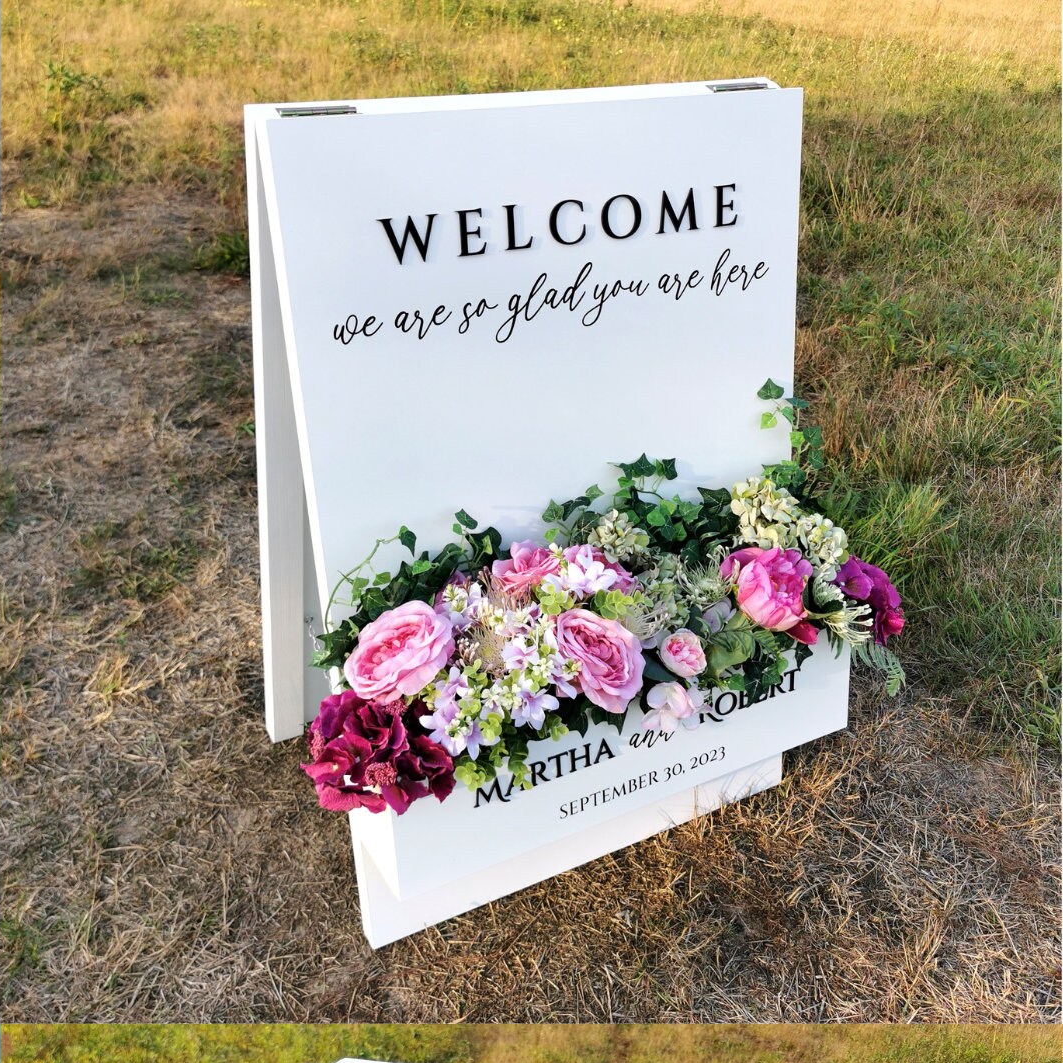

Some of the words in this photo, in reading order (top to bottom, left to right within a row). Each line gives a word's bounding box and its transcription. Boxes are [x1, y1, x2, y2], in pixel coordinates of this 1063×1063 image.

[376, 183, 738, 265] WELCOME
[333, 314, 384, 346] we
[394, 304, 453, 340] are
[458, 298, 499, 335] so
[495, 261, 593, 344] glad
[581, 279, 650, 327] you
[657, 269, 704, 301] are
[710, 248, 770, 297] here
[559, 770, 659, 819] SEPTEMBER
[663, 763, 687, 783] 30,
[690, 746, 726, 770] 2023
